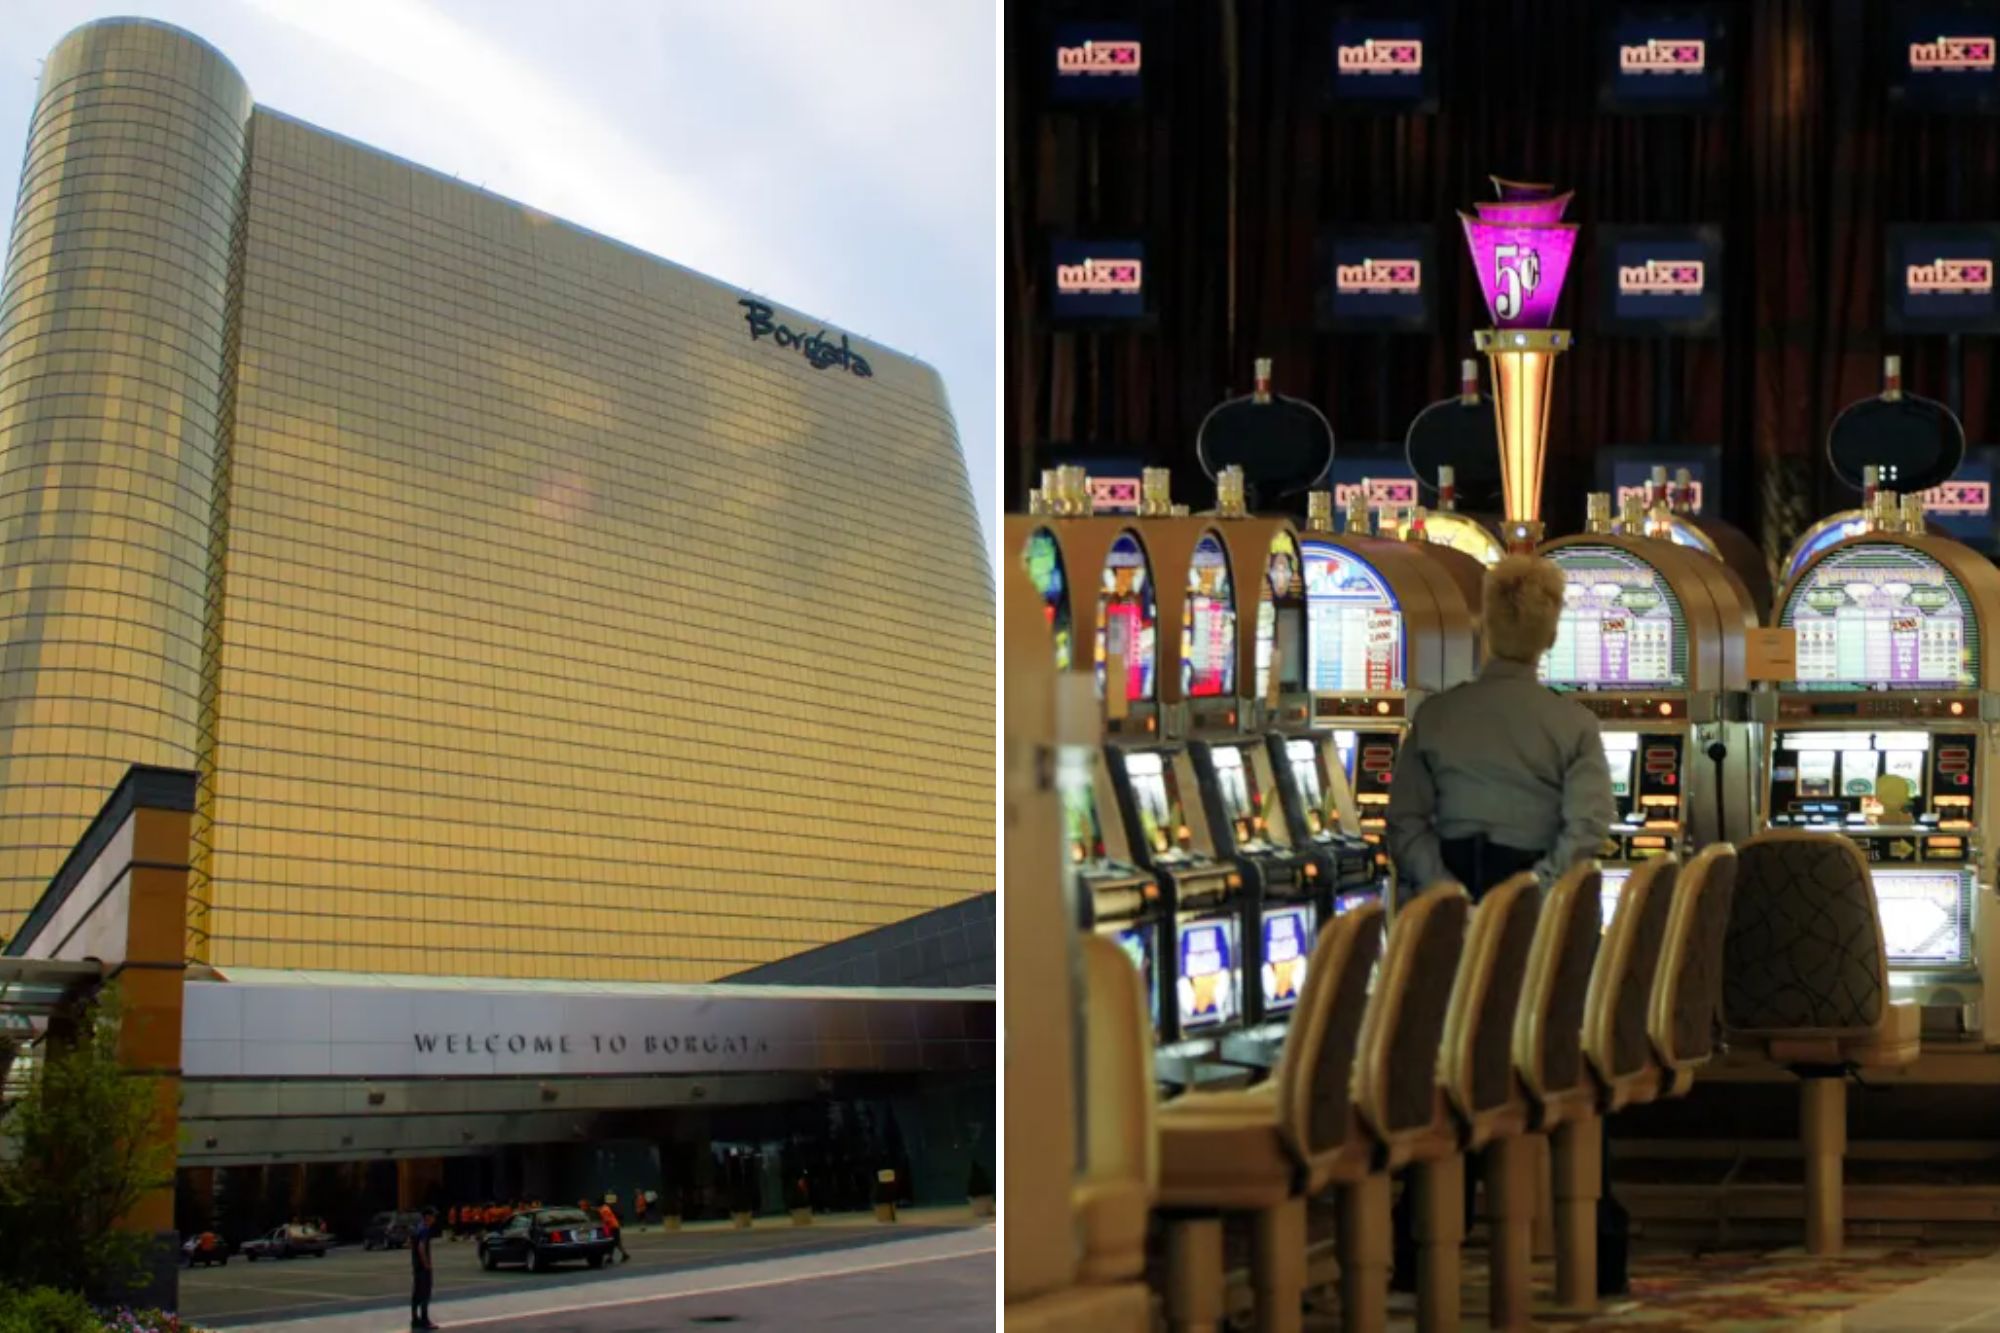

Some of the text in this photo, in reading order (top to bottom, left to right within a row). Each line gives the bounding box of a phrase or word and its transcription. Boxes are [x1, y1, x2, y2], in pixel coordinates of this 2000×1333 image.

[1058, 40, 1141, 71] mixx
[1338, 38, 1422, 71] mixx
[1620, 38, 1705, 70] mixx
[1910, 36, 1995, 68] mixx
[1057, 258, 1141, 290] mixx
[1337, 258, 1421, 290] mixx
[1619, 259, 1704, 291] mixx
[1907, 258, 1993, 290] mixx
[738, 298, 873, 378] Borgata
[414, 1033, 769, 1055] WELCOME TO BORGATA
